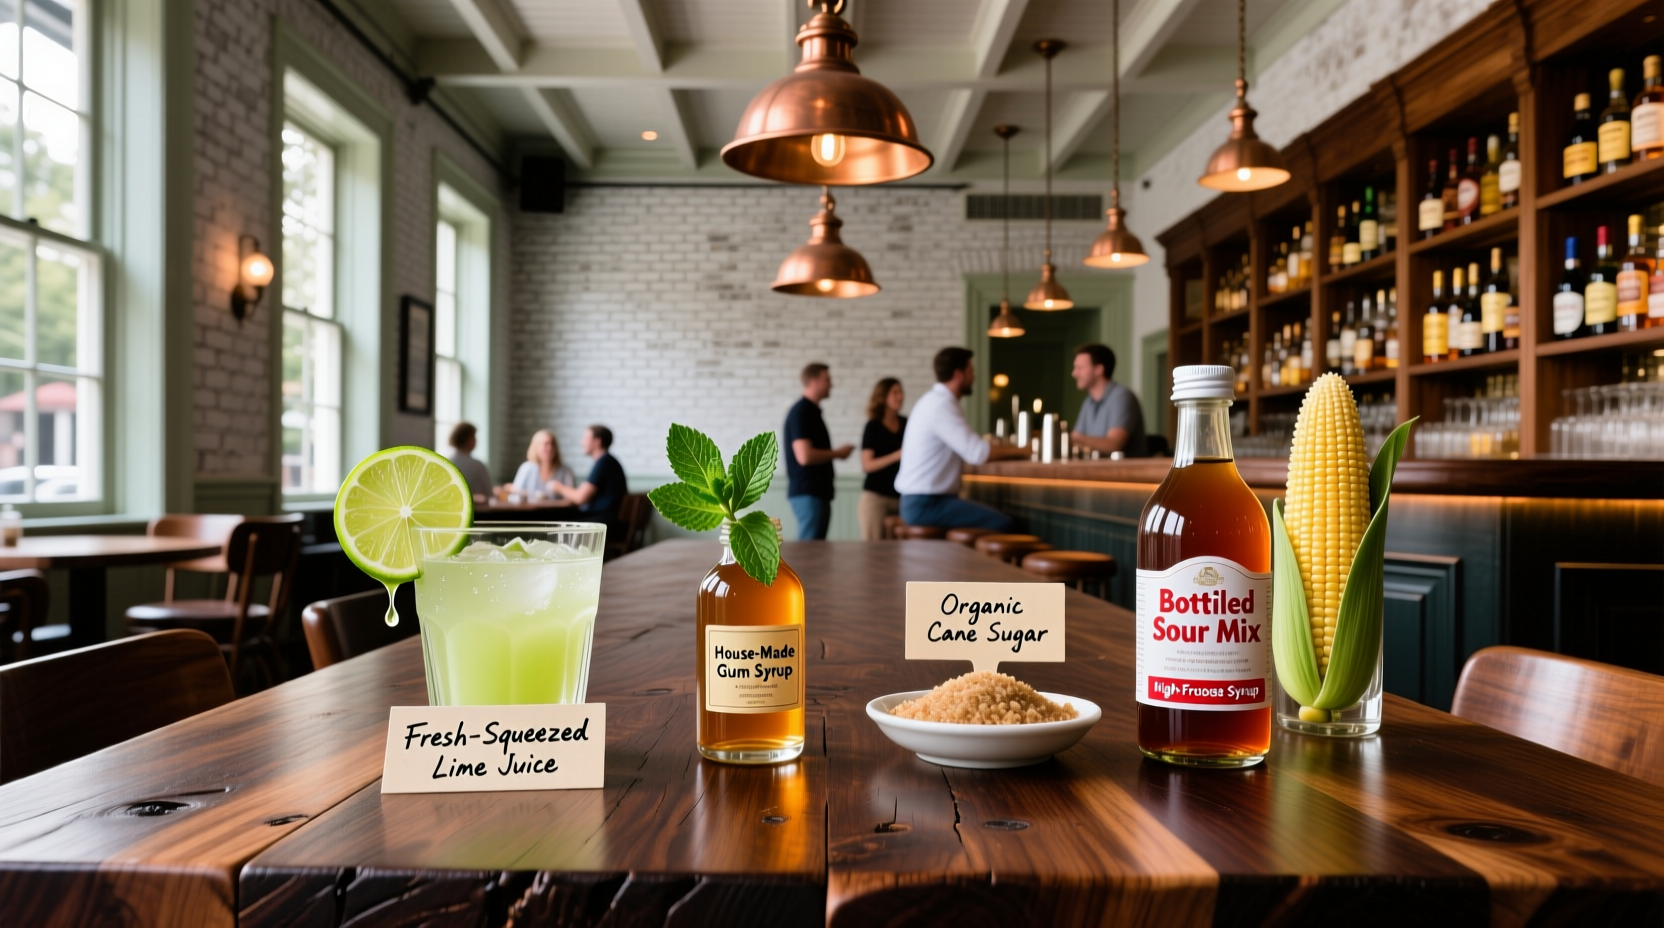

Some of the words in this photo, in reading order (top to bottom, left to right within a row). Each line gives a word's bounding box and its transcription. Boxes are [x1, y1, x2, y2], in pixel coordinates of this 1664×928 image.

[940, 592, 1024, 626] Organic
[1159, 588, 1255, 615] Bottiled
[927, 621, 978, 643] Cane
[986, 621, 1049, 653] Sugar
[1153, 616, 1210, 642] Sour
[1216, 618, 1261, 643] Mix
[715, 643, 796, 660] House-Made
[717, 663, 750, 679] Gum
[754, 663, 793, 682] Syrup
[404, 717, 589, 755] Fresh-Squeezed
[432, 754, 487, 779] Lime
[497, 753, 559, 776] Juice
